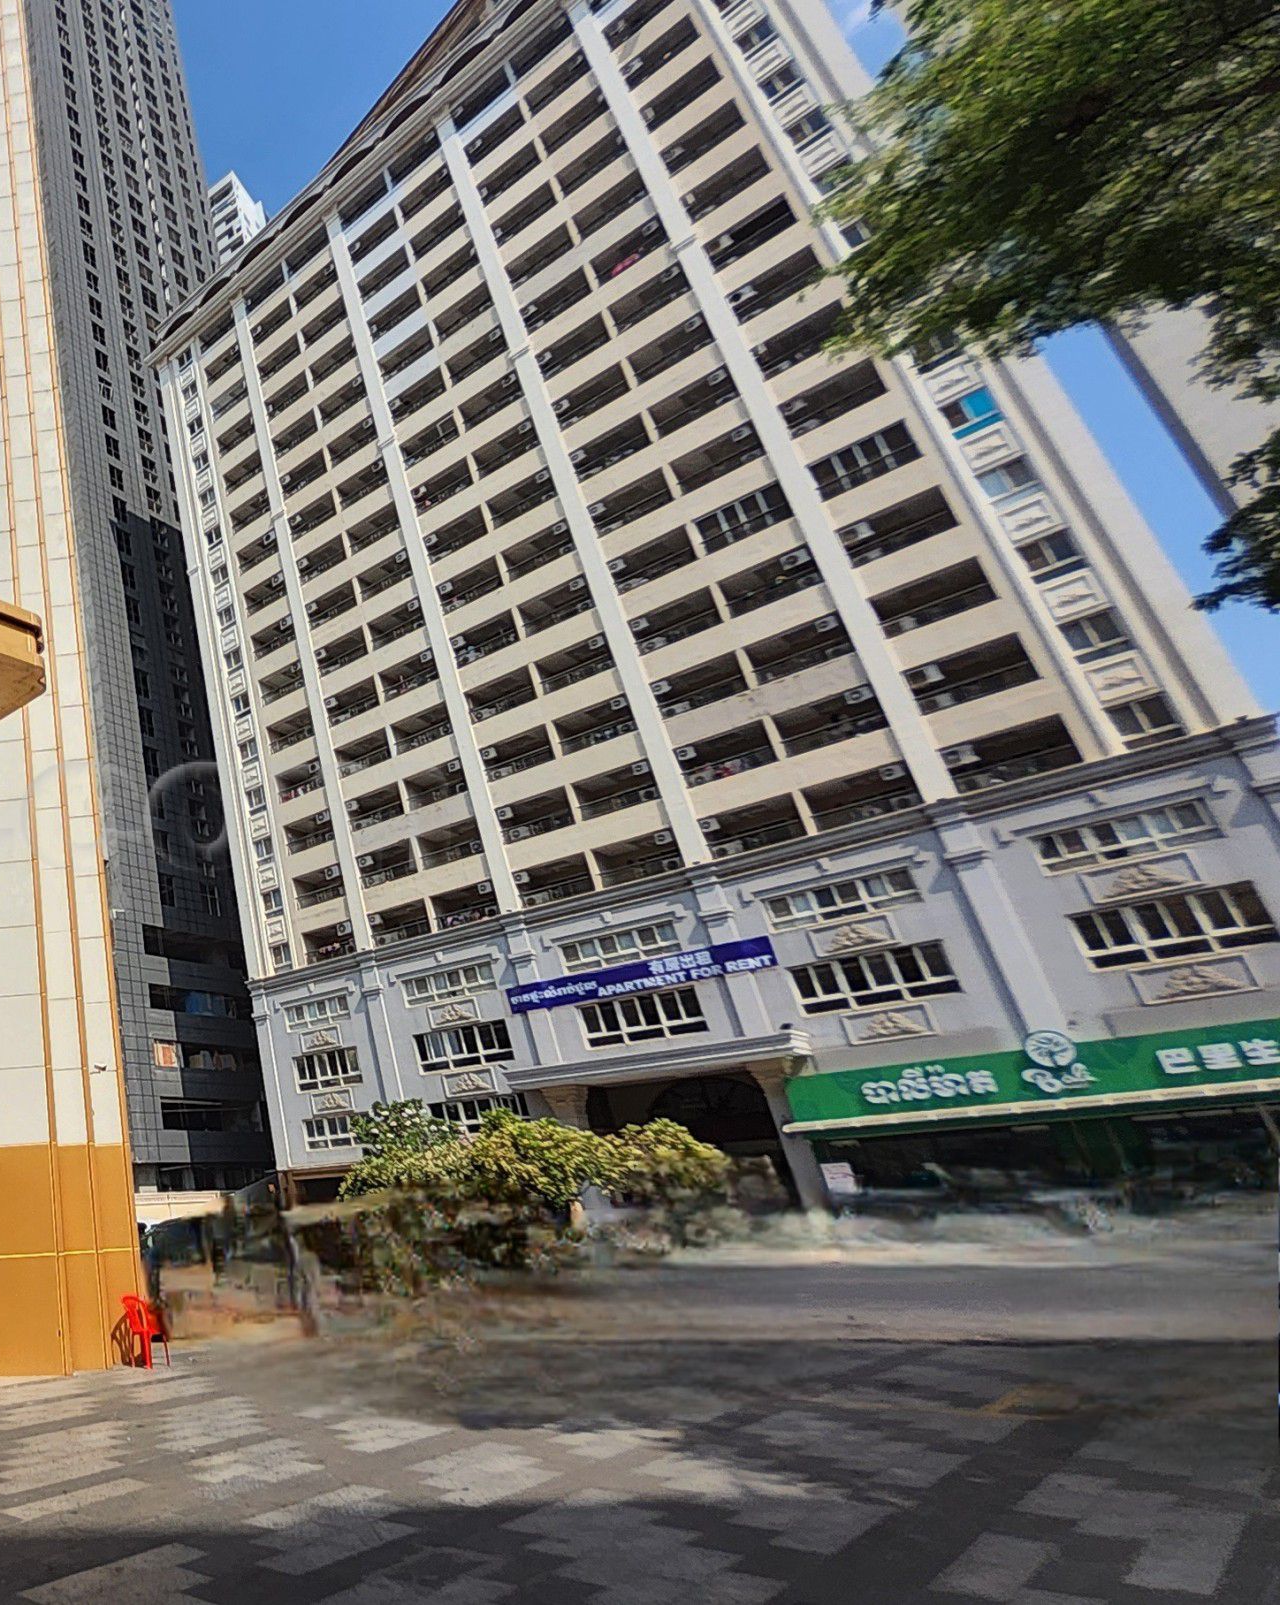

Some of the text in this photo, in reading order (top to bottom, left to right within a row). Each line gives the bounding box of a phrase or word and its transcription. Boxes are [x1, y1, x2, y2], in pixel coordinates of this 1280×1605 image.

[597, 954, 773, 997] APARTMENT FOR RENT
